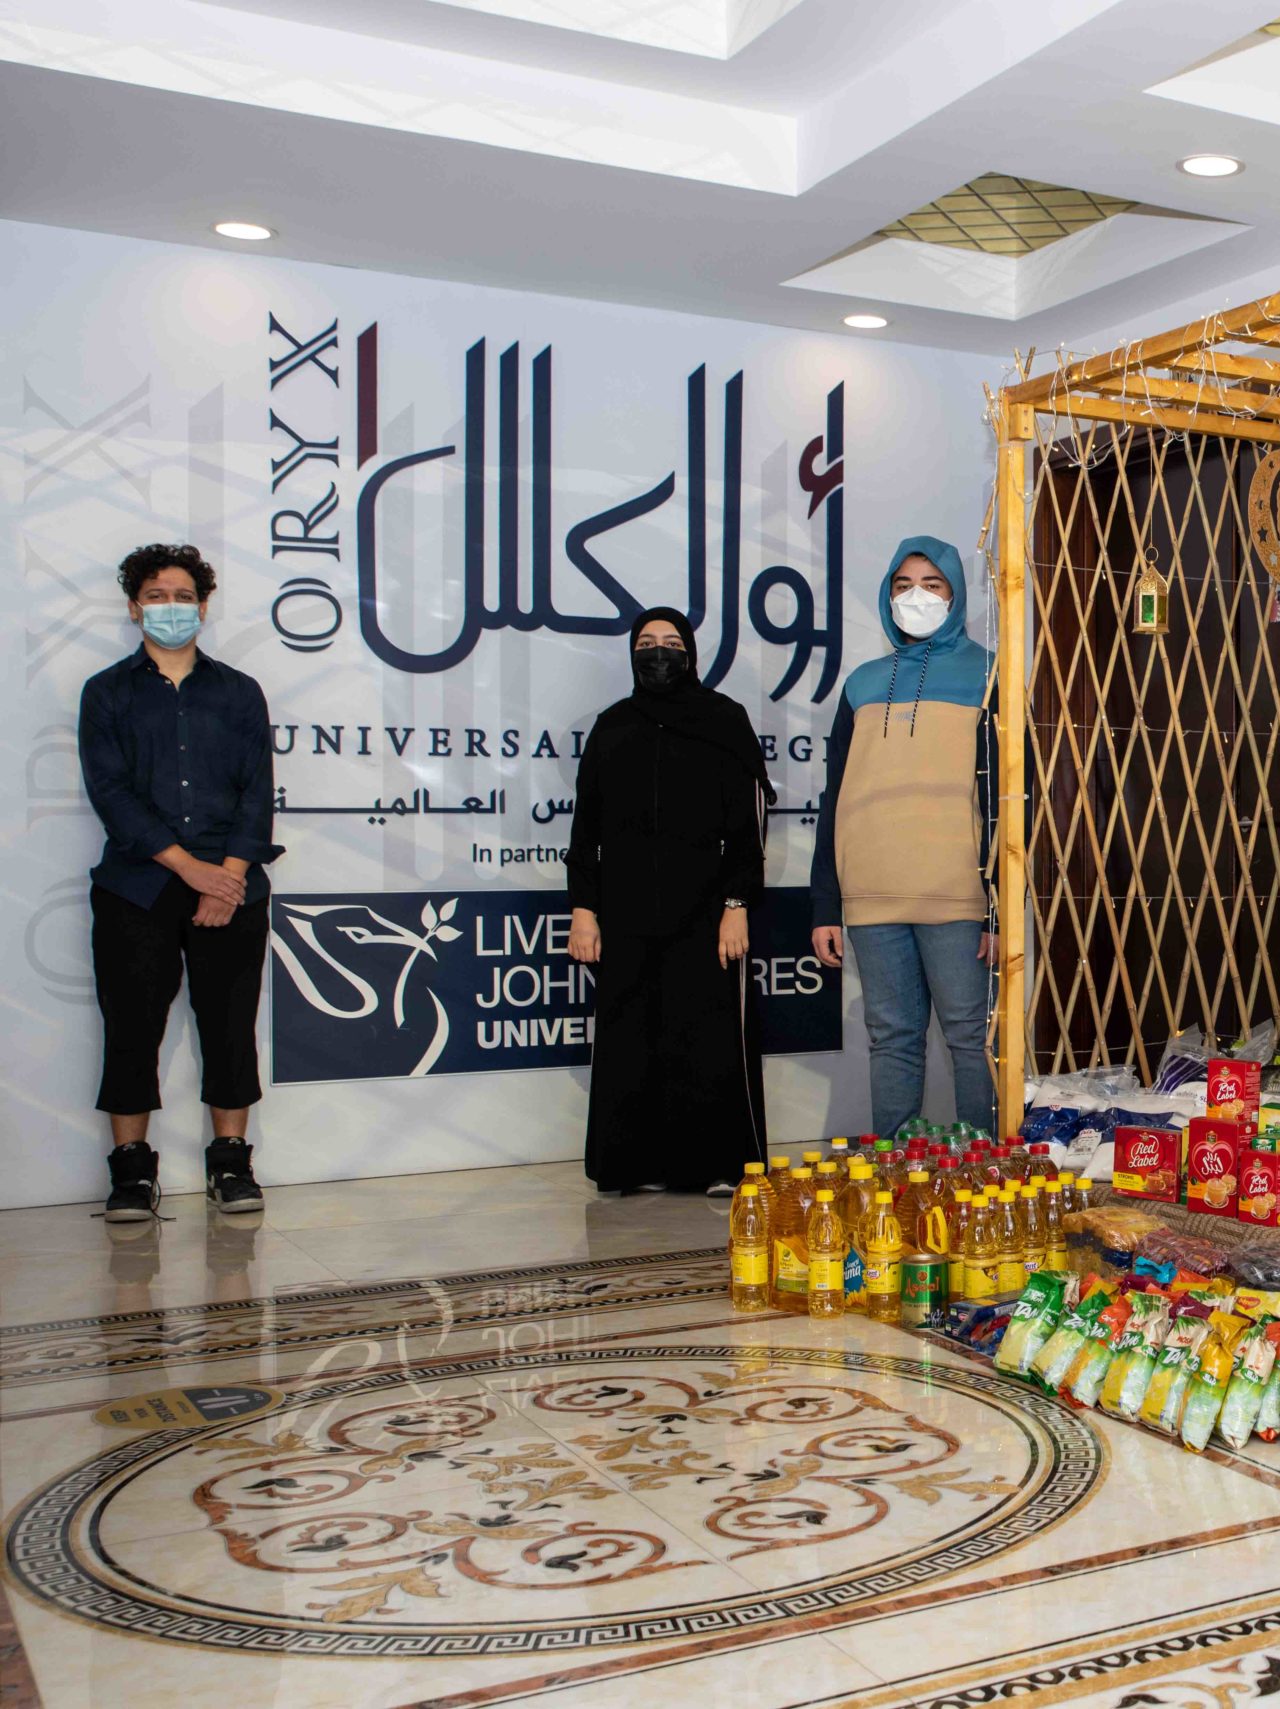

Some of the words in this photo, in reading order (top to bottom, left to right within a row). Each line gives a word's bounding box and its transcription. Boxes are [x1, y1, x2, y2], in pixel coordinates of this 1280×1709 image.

[268, 311, 342, 653] ORYX
[473, 843, 492, 862] In
[500, 844, 567, 867] partne
[1219, 1083, 1236, 1093] Red
[1216, 1091, 1237, 1101] Label
[1134, 1141, 1156, 1155] Red
[1128, 1154, 1159, 1168] Label
[1251, 1175, 1267, 1185] Red
[1249, 1184, 1268, 1194] Label
